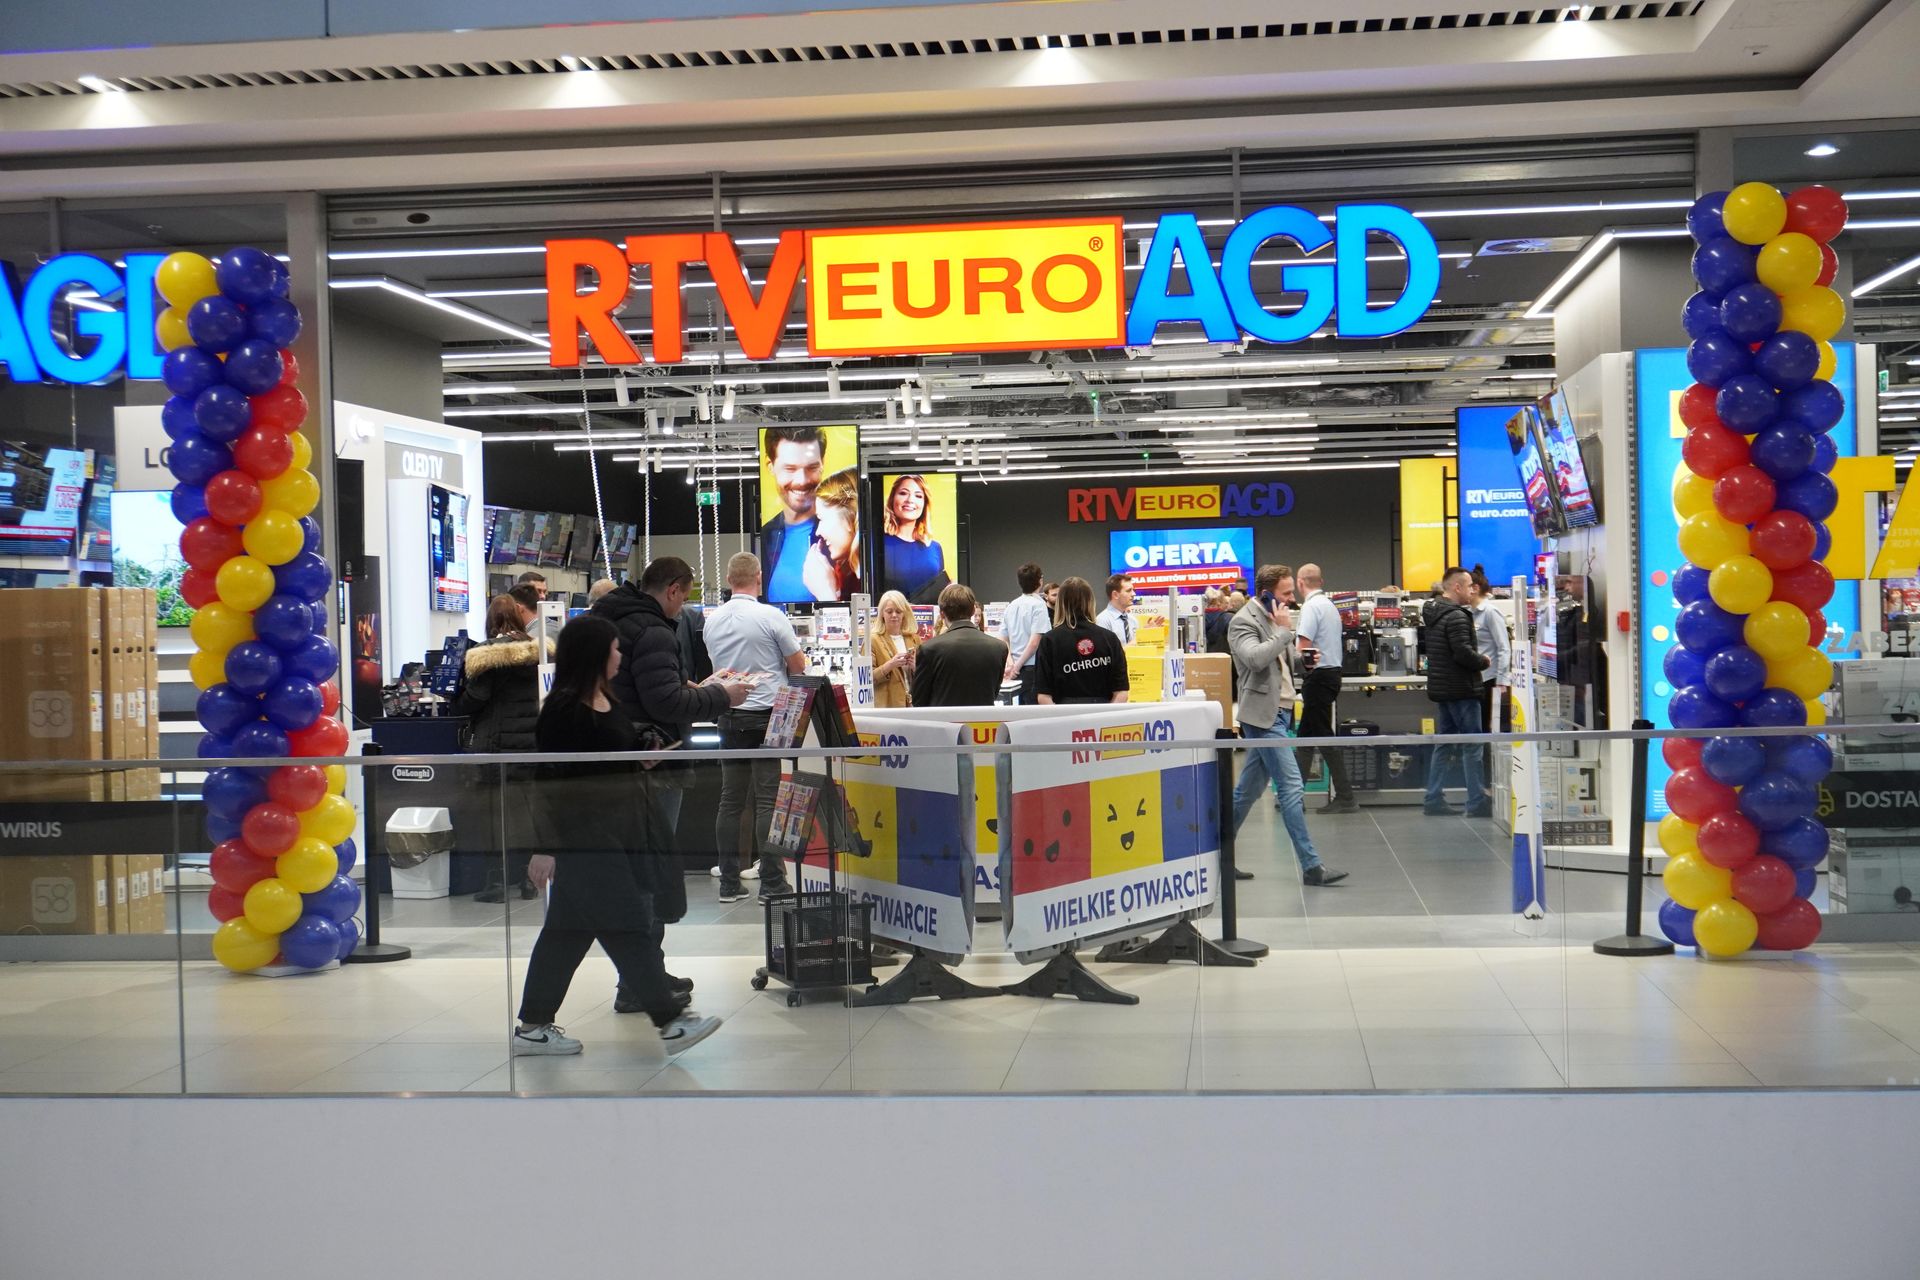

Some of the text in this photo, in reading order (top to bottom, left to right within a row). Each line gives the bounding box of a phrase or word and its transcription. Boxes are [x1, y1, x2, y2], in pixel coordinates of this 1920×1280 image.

[545, 202, 1441, 367] RTV EURO AGD
[429, 455, 443, 480] TV
[1068, 482, 1295, 522] RTV EURO AGD
[1466, 489, 1525, 504] RTV EURO
[1470, 508, 1529, 518] euro.com
[1125, 541, 1238, 568] OFERTA
[1063, 656, 1112, 674] OCHRONA
[1072, 729, 1102, 765] RTV
[1143, 720, 1175, 754] AGD
[396, 768, 430, 779] DeLonghi
[1845, 790, 1920, 809] DOSTA
[1043, 867, 1208, 933] WIELKIE OTWARCIE
